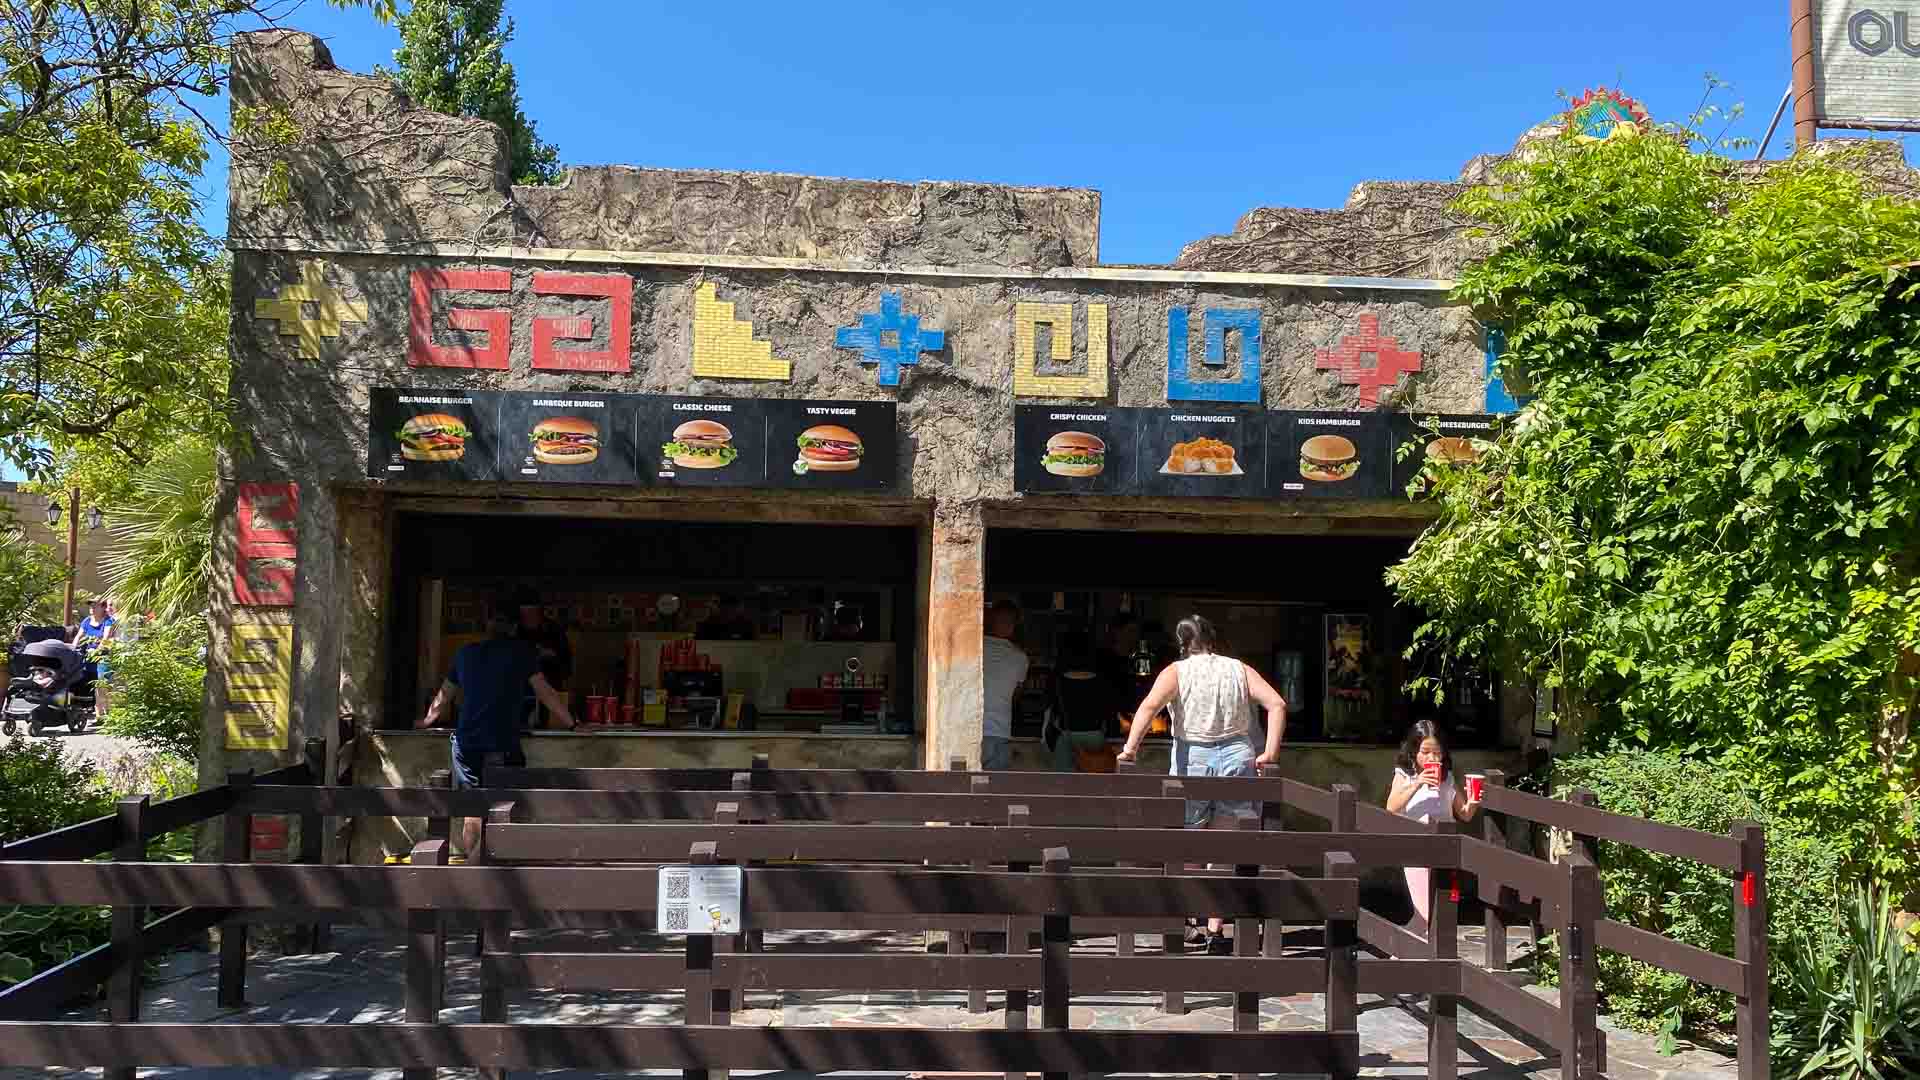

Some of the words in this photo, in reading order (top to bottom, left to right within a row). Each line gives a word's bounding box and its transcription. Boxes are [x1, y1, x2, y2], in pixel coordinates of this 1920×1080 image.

[399, 396, 441, 404] BEARNAISE
[442, 396, 473, 405] BURGER
[532, 399, 573, 408] BARBEQUE
[574, 400, 605, 408] BURGER
[672, 403, 703, 411] CLASSIC
[703, 404, 733, 412] CHEESE
[806, 407, 830, 415] TASTY
[1050, 413, 1076, 421] CRISPY
[1076, 414, 1107, 422] CHICKEN
[1170, 414, 1201, 422] CHICKEN
[1202, 415, 1236, 423] NUGGETS
[1315, 418, 1361, 426] HAMBURGER
[1418, 420, 1434, 428] KID
[1435, 421, 1490, 429] HEESEBURGER
